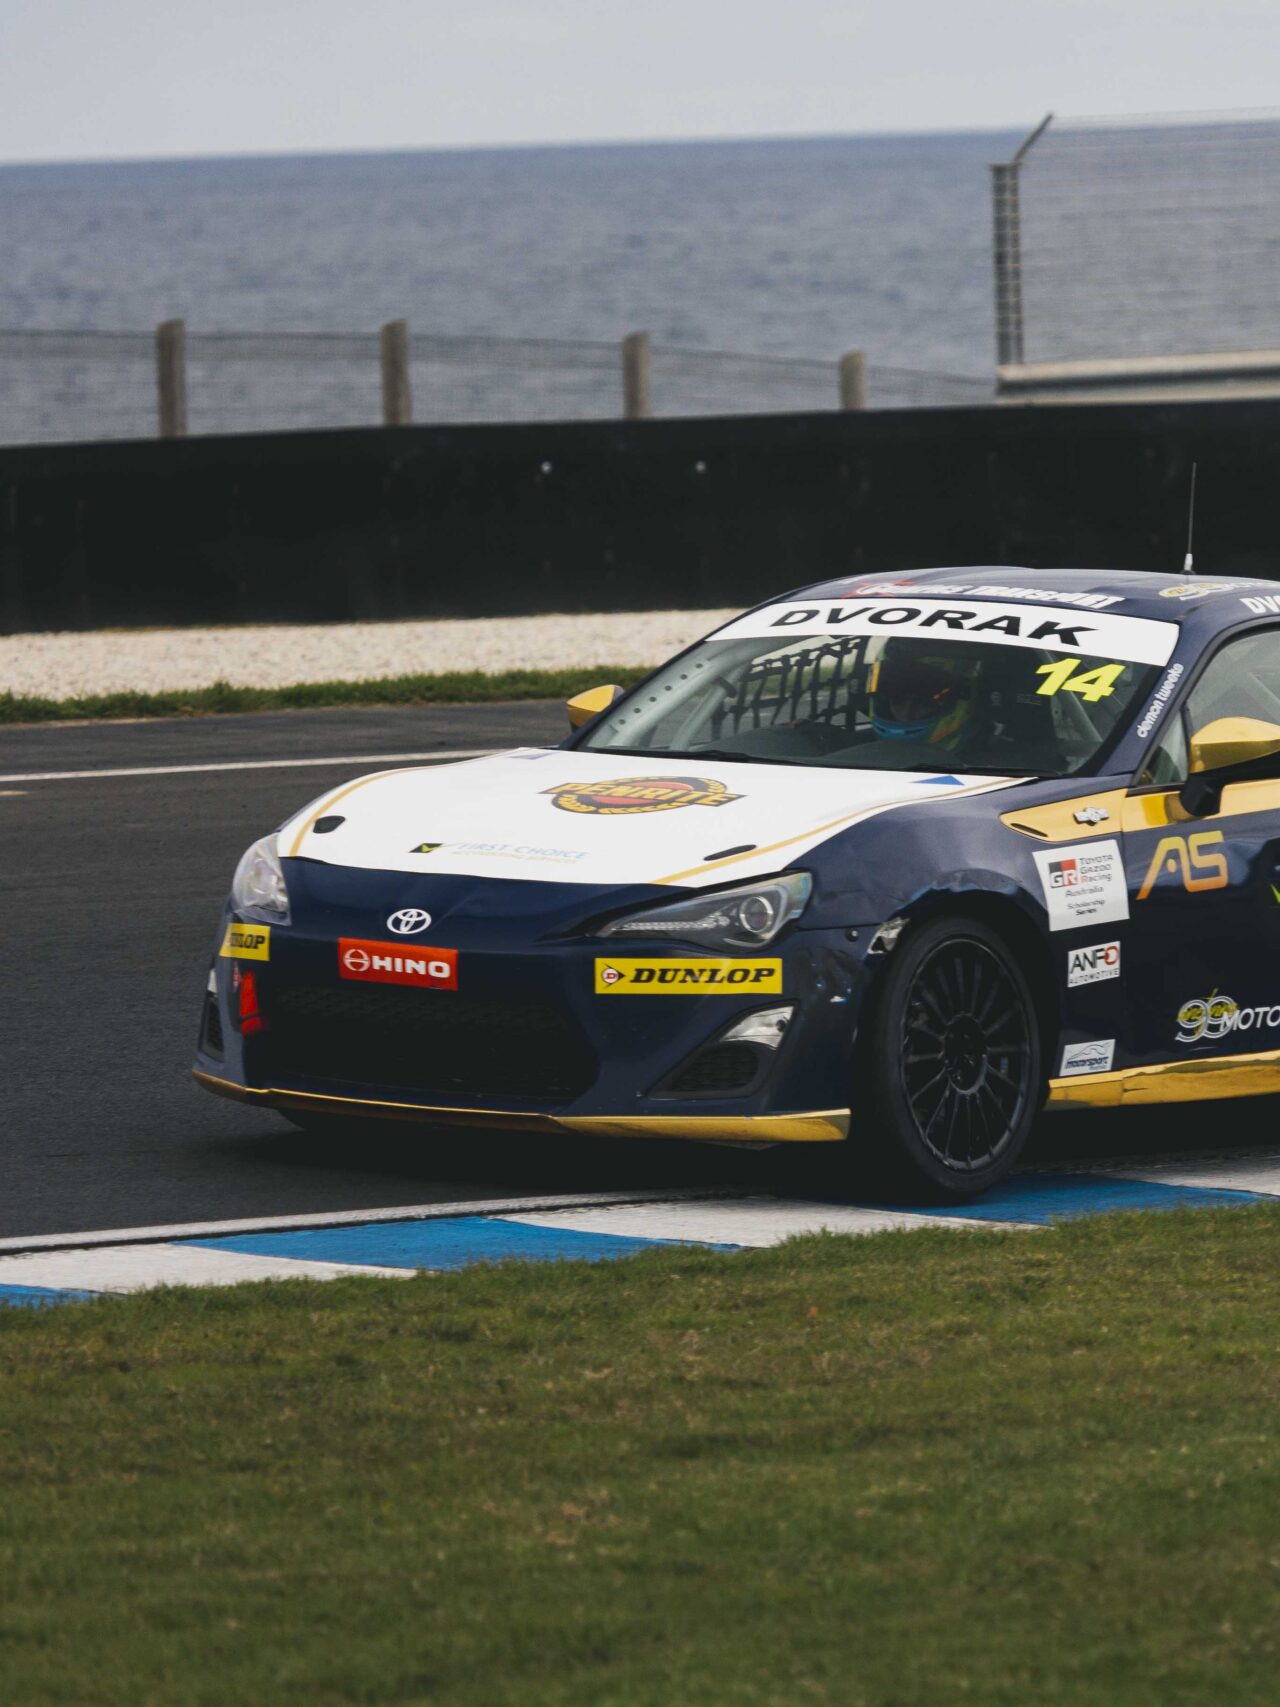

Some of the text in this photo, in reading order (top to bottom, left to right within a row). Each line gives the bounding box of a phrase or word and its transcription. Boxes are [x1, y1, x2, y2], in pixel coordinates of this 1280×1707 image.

[769, 606, 1099, 647] DVORAK
[1035, 658, 1127, 702] 14
[1136, 663, 1184, 738] demon tweeks
[546, 783, 738, 805] PENRITE
[371, 955, 451, 979] HINO
[629, 968, 776, 984] DUNLOP
